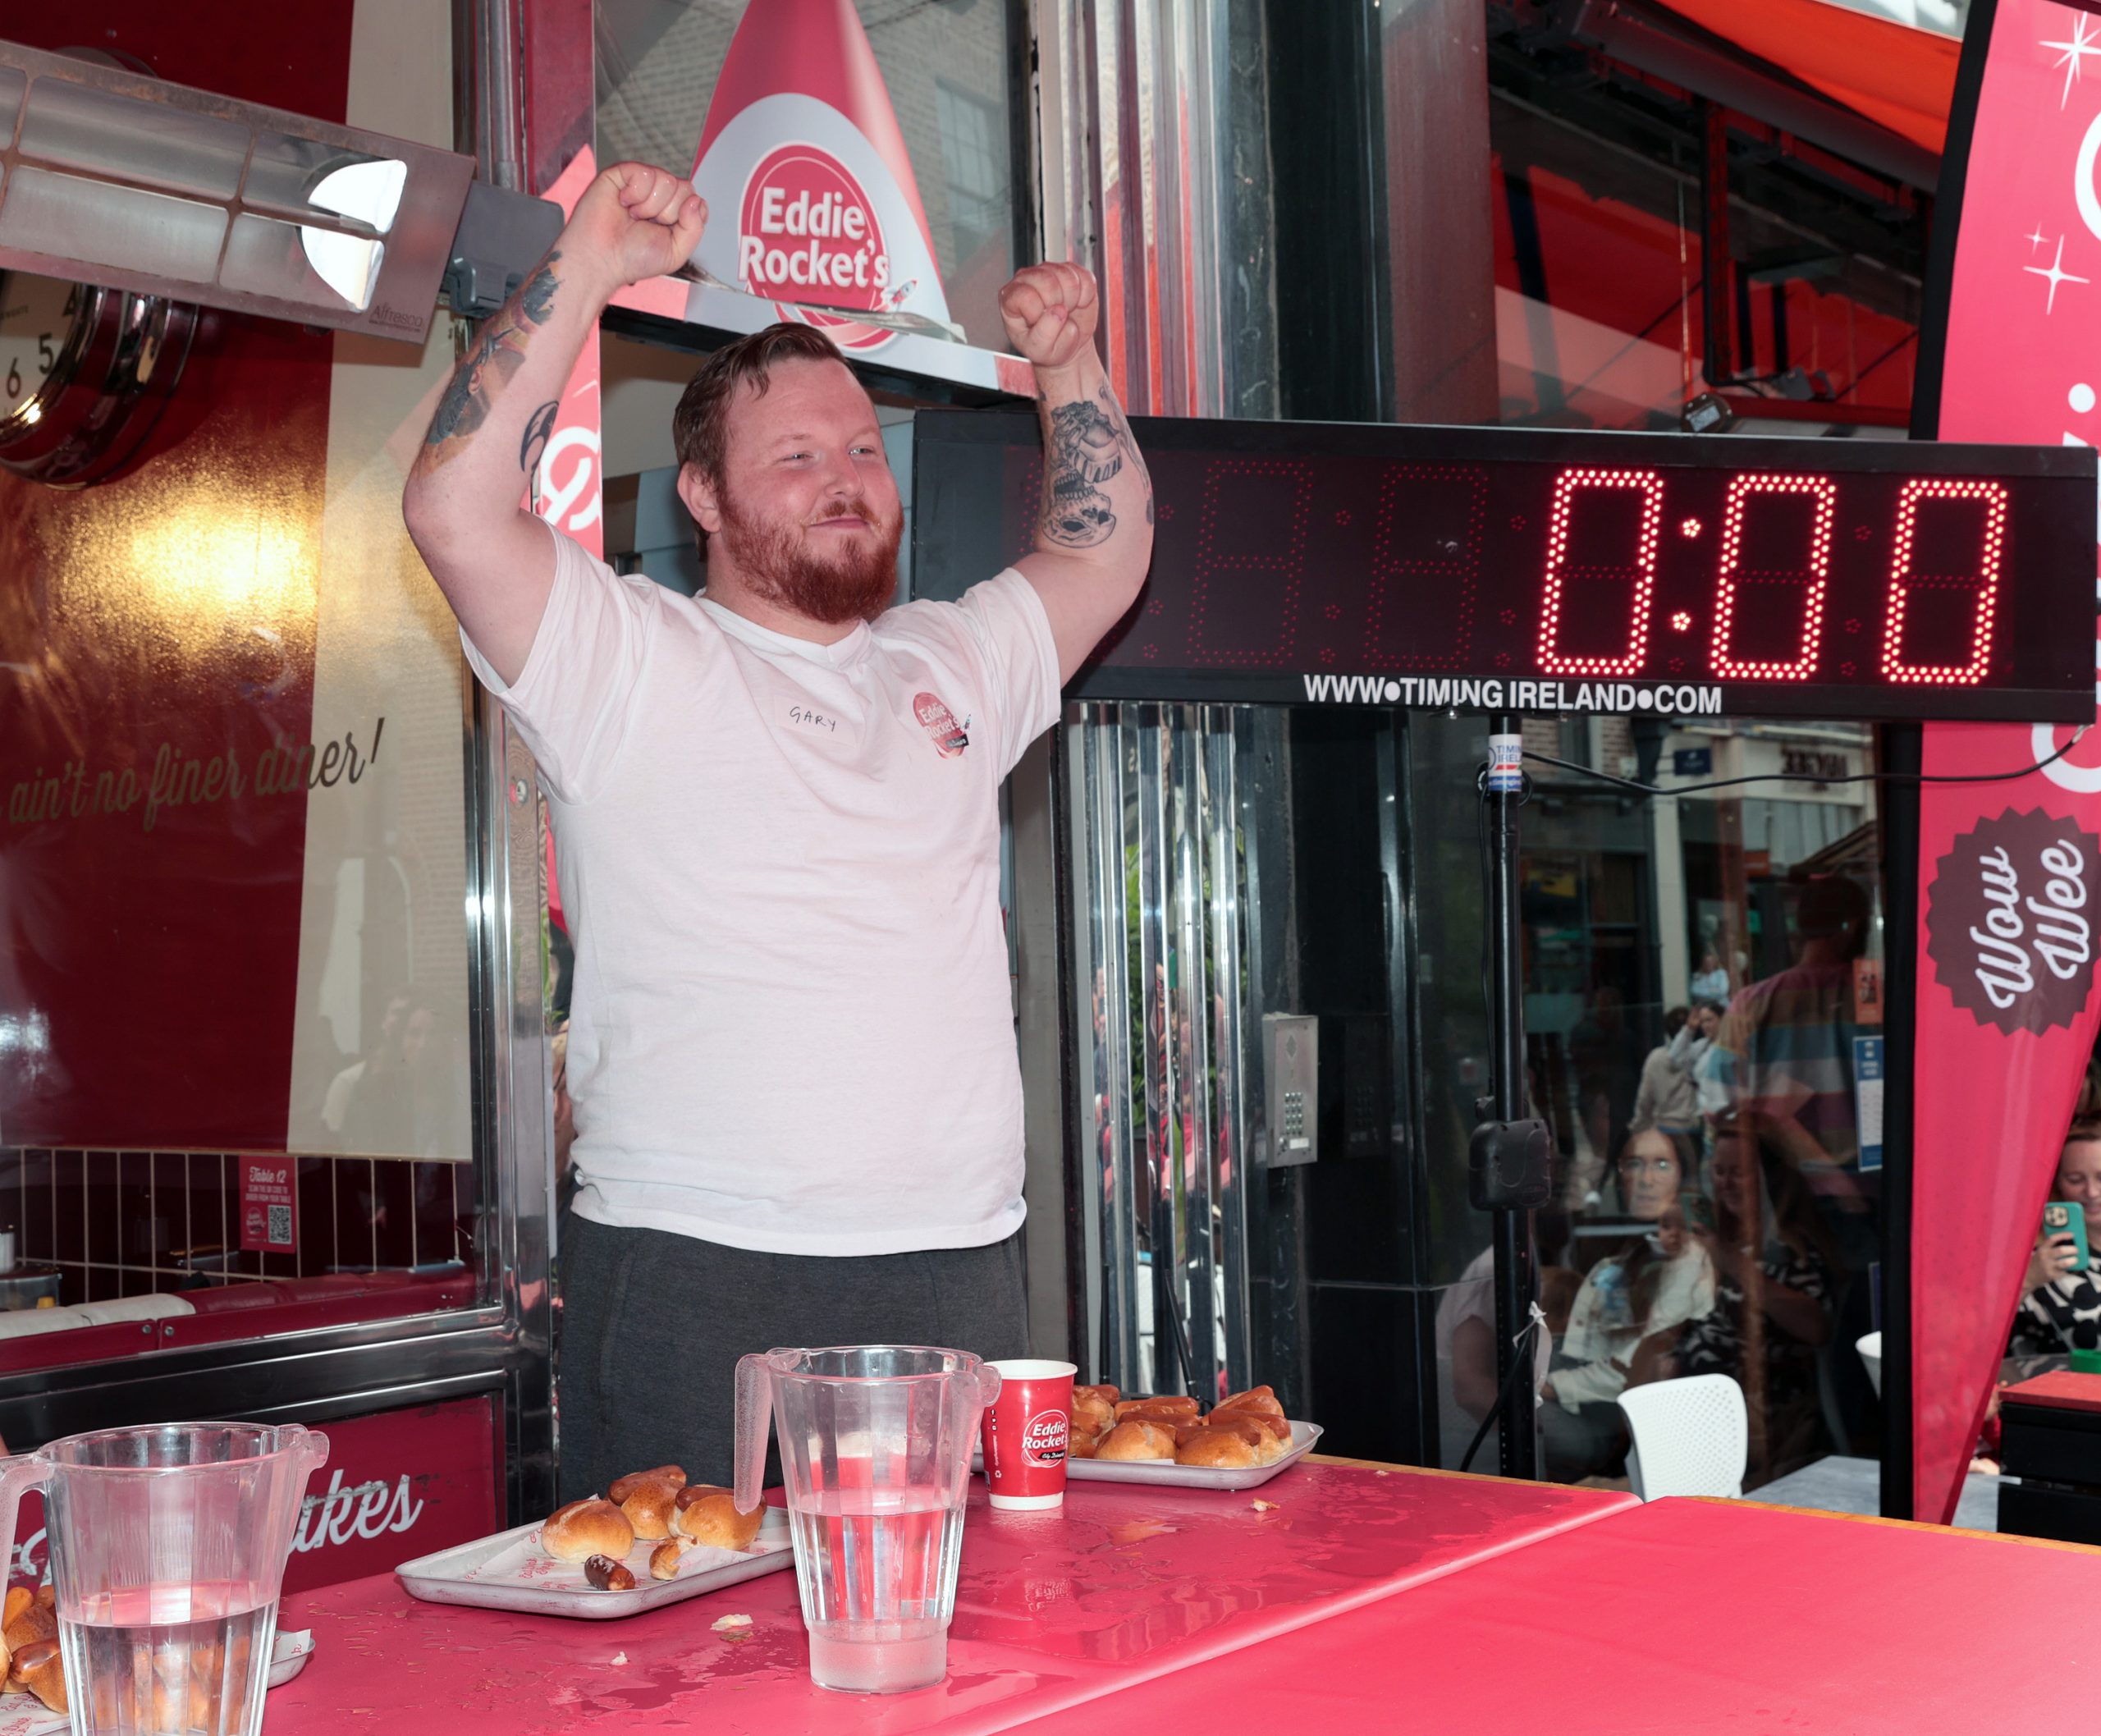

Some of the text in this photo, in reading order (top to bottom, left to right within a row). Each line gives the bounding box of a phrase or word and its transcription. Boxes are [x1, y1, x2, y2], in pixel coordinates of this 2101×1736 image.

[760, 186, 867, 240] Eddie
[738, 235, 890, 288] Rocket's
[369, 302, 423, 328] Alfresco
[39, 332, 54, 375] 5
[7, 357, 21, 399] 6
[789, 706, 837, 733] GARY
[918, 703, 947, 725] Eddie
[925, 713, 960, 740] Rocket's
[10, 717, 386, 832] ain't no finer diner!
[1970, 845, 2035, 1009] Wow
[2025, 839, 2090, 979] Wee
[249, 1166, 287, 1184] Table 12
[1032, 1420, 1066, 1437] Eddie
